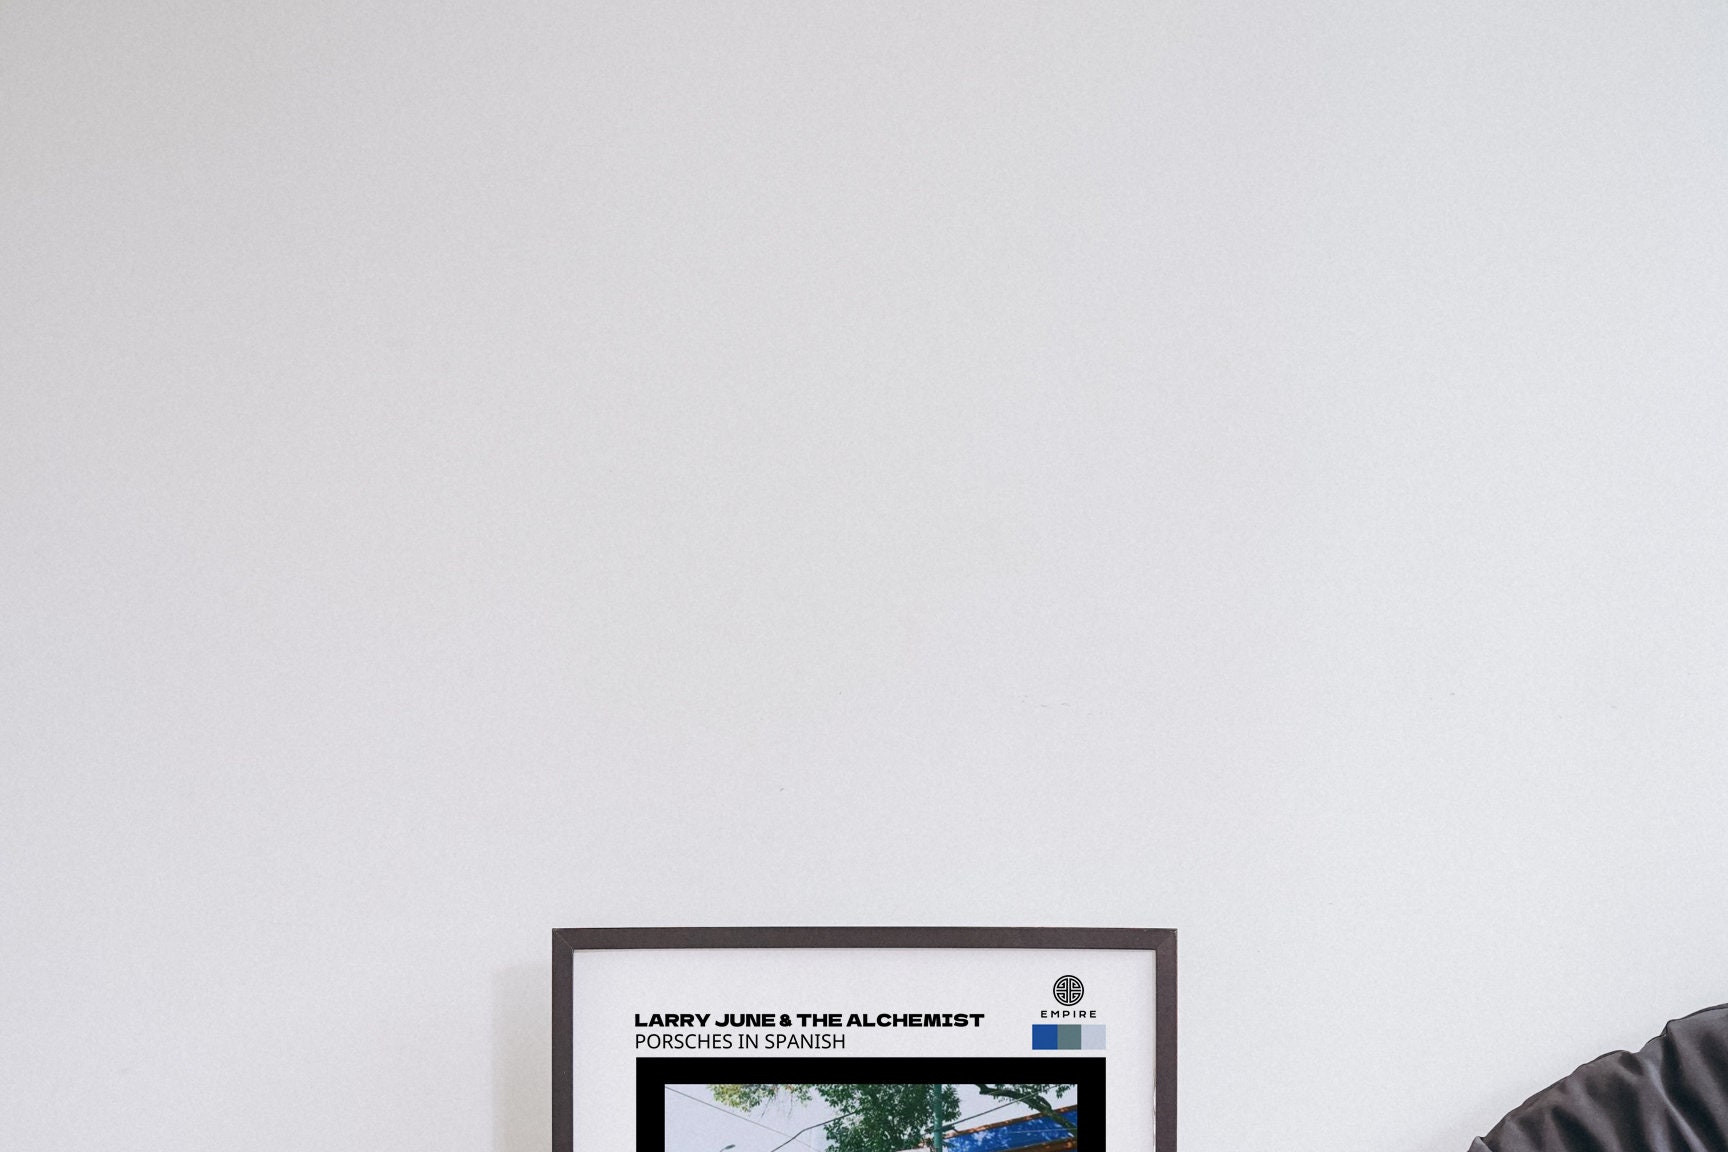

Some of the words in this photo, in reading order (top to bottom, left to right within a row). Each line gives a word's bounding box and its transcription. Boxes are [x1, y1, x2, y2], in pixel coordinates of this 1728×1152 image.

[635, 1014, 710, 1028] LARRY
[715, 1014, 775, 1028] JUNE
[780, 1014, 792, 1028] &
[797, 1014, 843, 1028] THE
[846, 1014, 984, 1028] ALCHEMIST
[1041, 1010, 1097, 1018] EMPIRE
[635, 1034, 733, 1049] PORSCHES
[738, 1034, 759, 1049] IN
[764, 1034, 845, 1049] SPANISH
